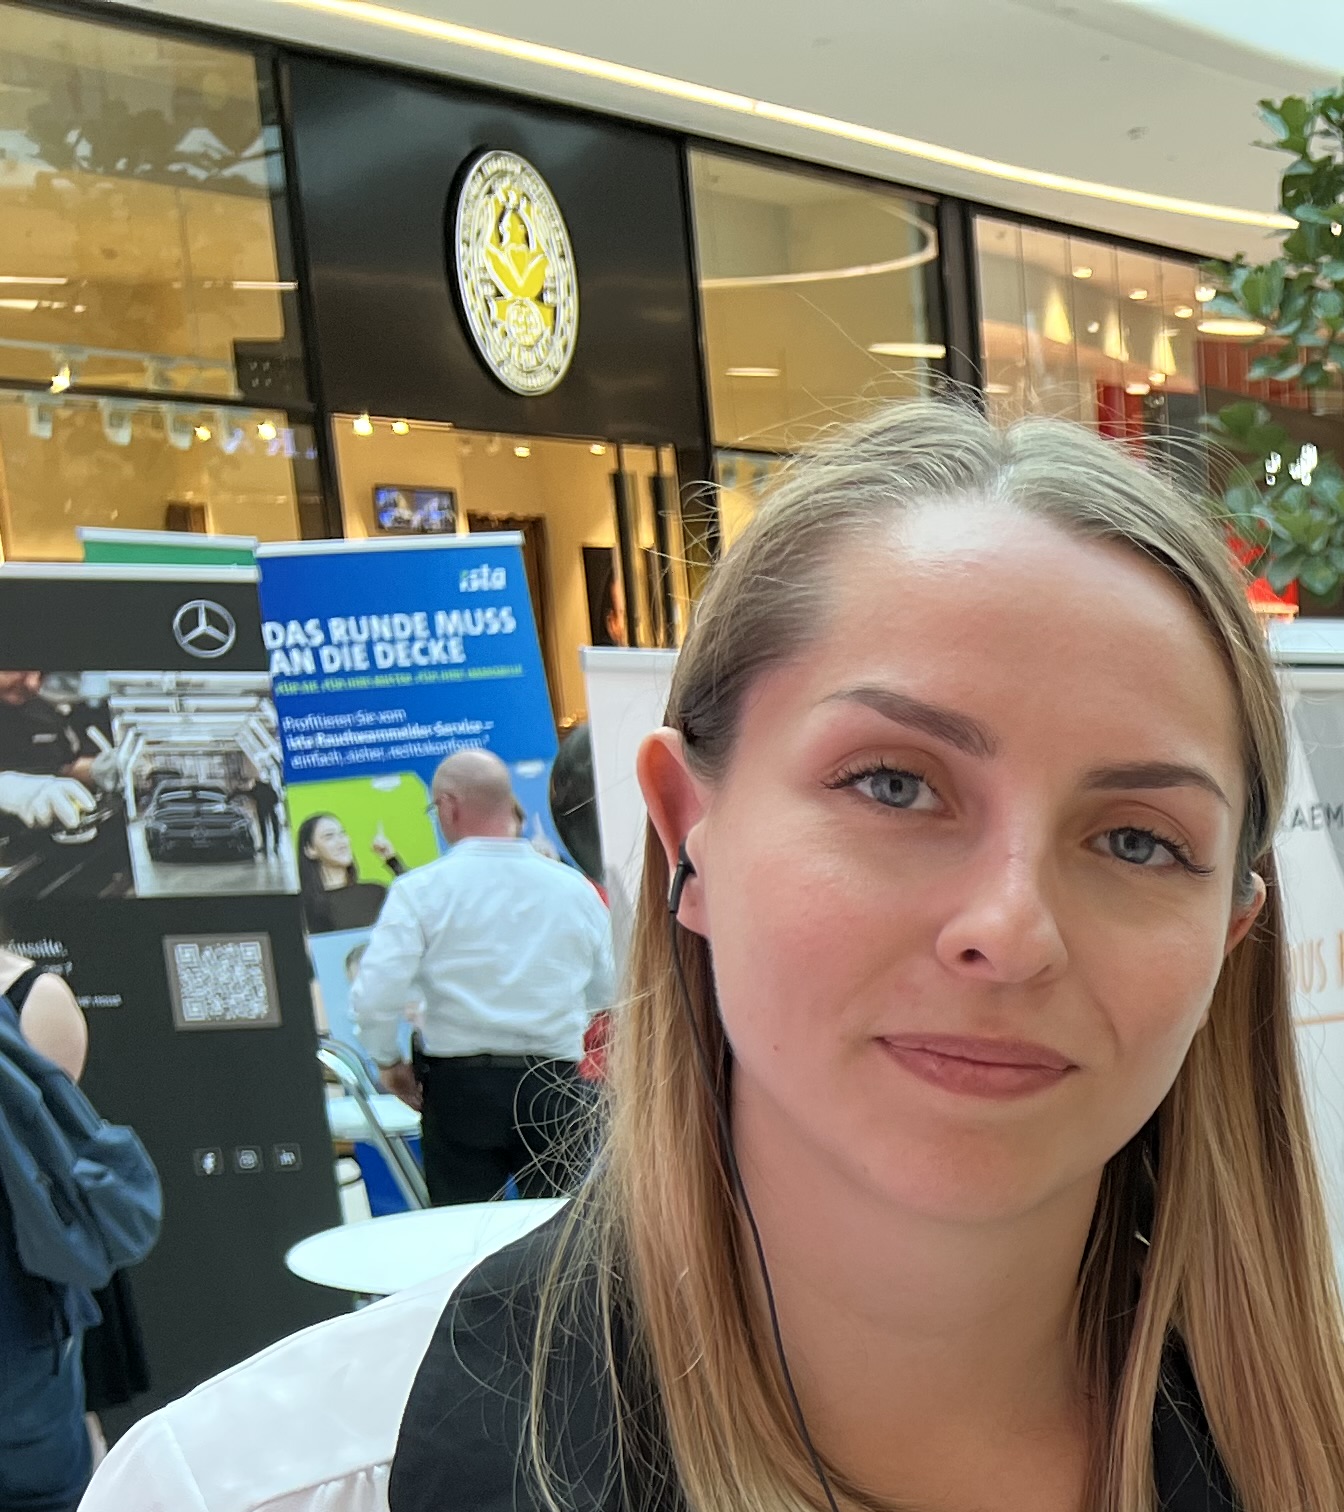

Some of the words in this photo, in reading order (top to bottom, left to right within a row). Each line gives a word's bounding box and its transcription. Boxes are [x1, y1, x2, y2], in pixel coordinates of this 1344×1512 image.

[459, 564, 507, 593] ista
[262, 618, 324, 649] DAS
[327, 611, 430, 645] RUNDE
[434, 606, 517, 637] MUSS
[270, 646, 317, 677] AN
[319, 643, 371, 674] DIE
[373, 636, 467, 669] DECKE
